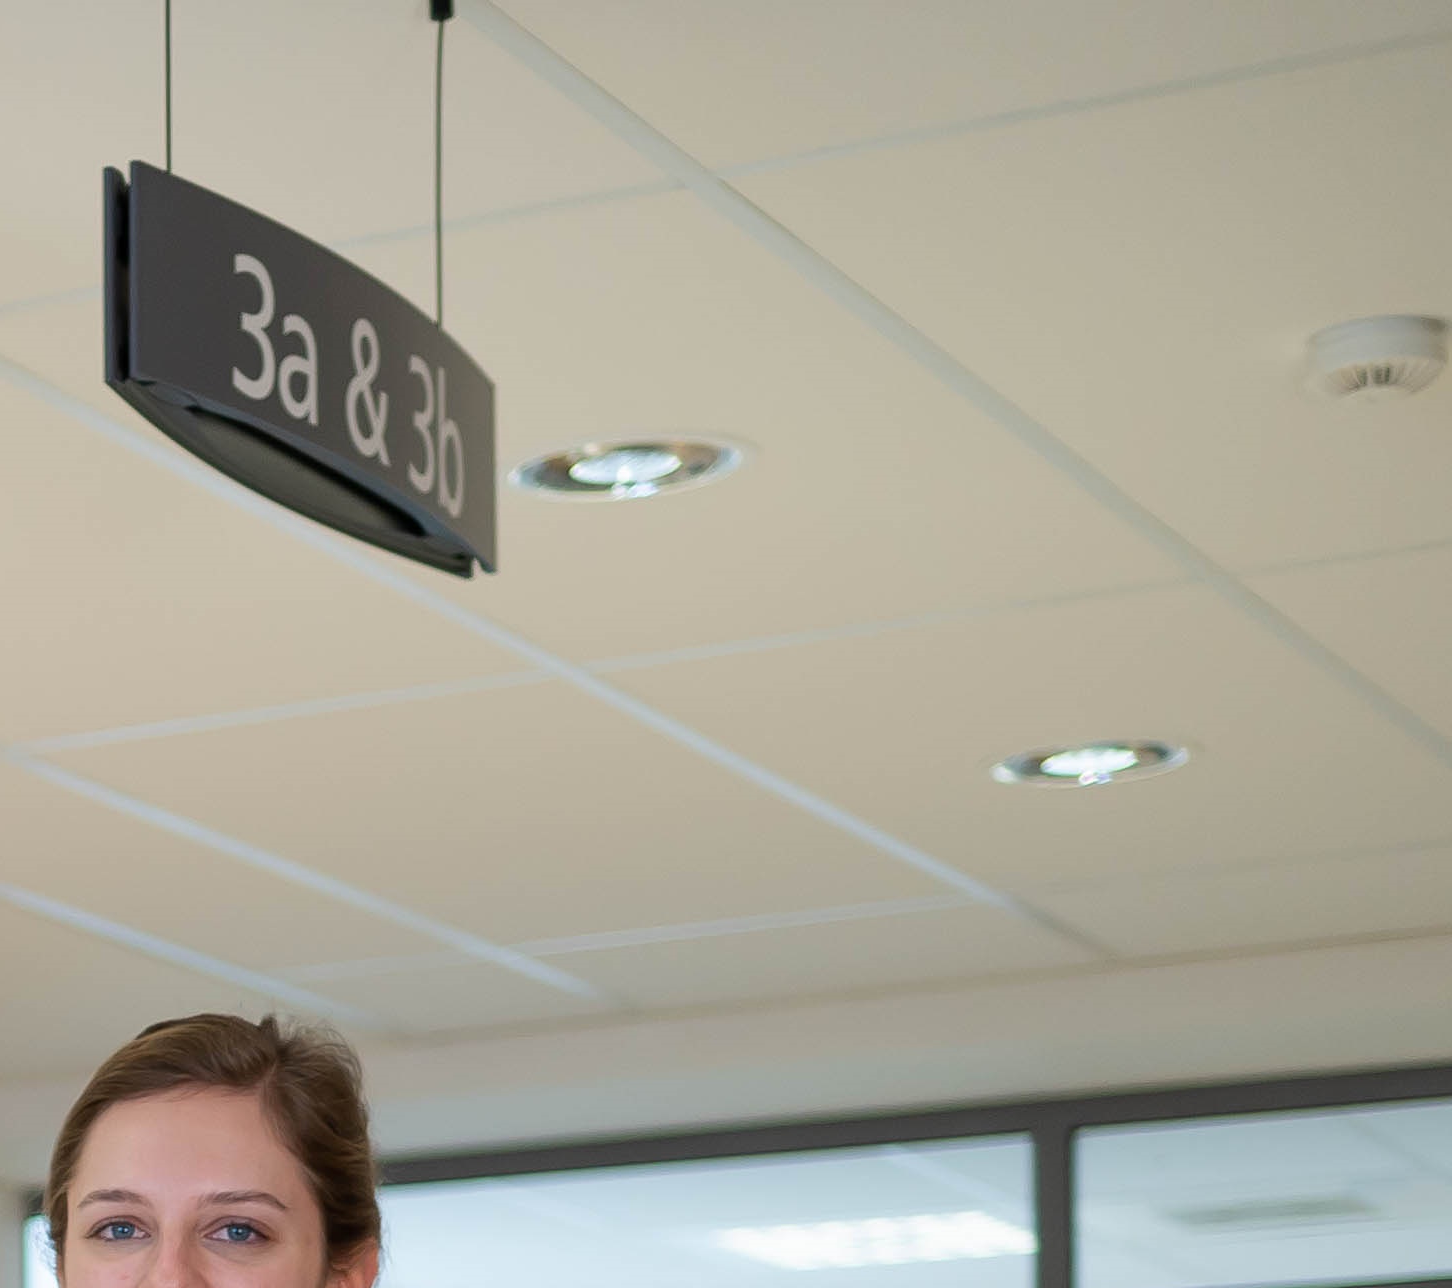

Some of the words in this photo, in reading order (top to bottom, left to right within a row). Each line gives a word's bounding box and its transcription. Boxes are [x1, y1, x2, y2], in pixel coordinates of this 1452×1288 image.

[232, 253, 318, 426] 3a
[346, 317, 392, 467] &
[407, 354, 465, 519] 3b
